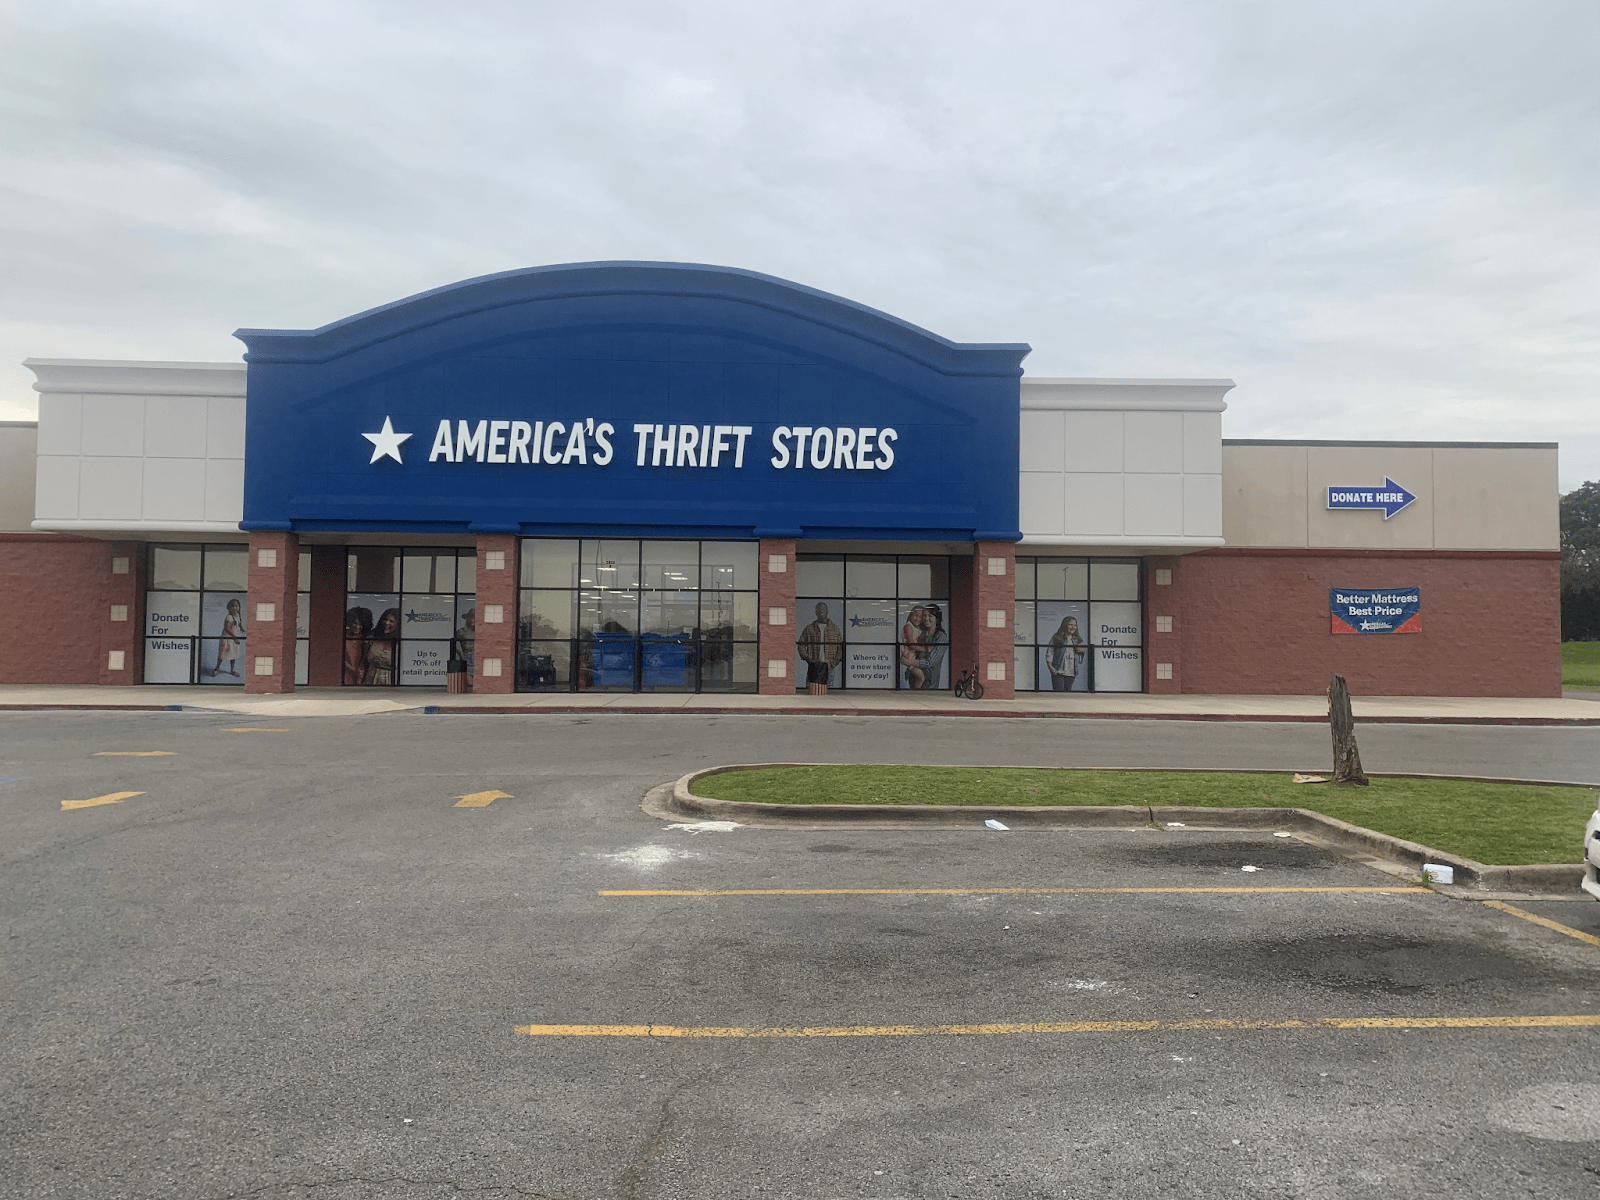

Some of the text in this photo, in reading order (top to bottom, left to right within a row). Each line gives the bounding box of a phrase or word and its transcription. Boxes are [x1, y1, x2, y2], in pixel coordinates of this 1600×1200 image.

[429, 417, 898, 471] AMERICA'S THRIFT STORES
[1331, 492, 1403, 503] DONATE HERE
[1336, 594, 1418, 604] Better Mattress
[1349, 606, 1402, 616] Best Price
[151, 613, 189, 622] Donate
[151, 626, 169, 635] For
[1101, 625, 1137, 634] Donate
[151, 641, 189, 650] Wishes
[1101, 637, 1118, 646] For
[417, 650, 428, 659] Up
[1101, 651, 1138, 660] Wishes
